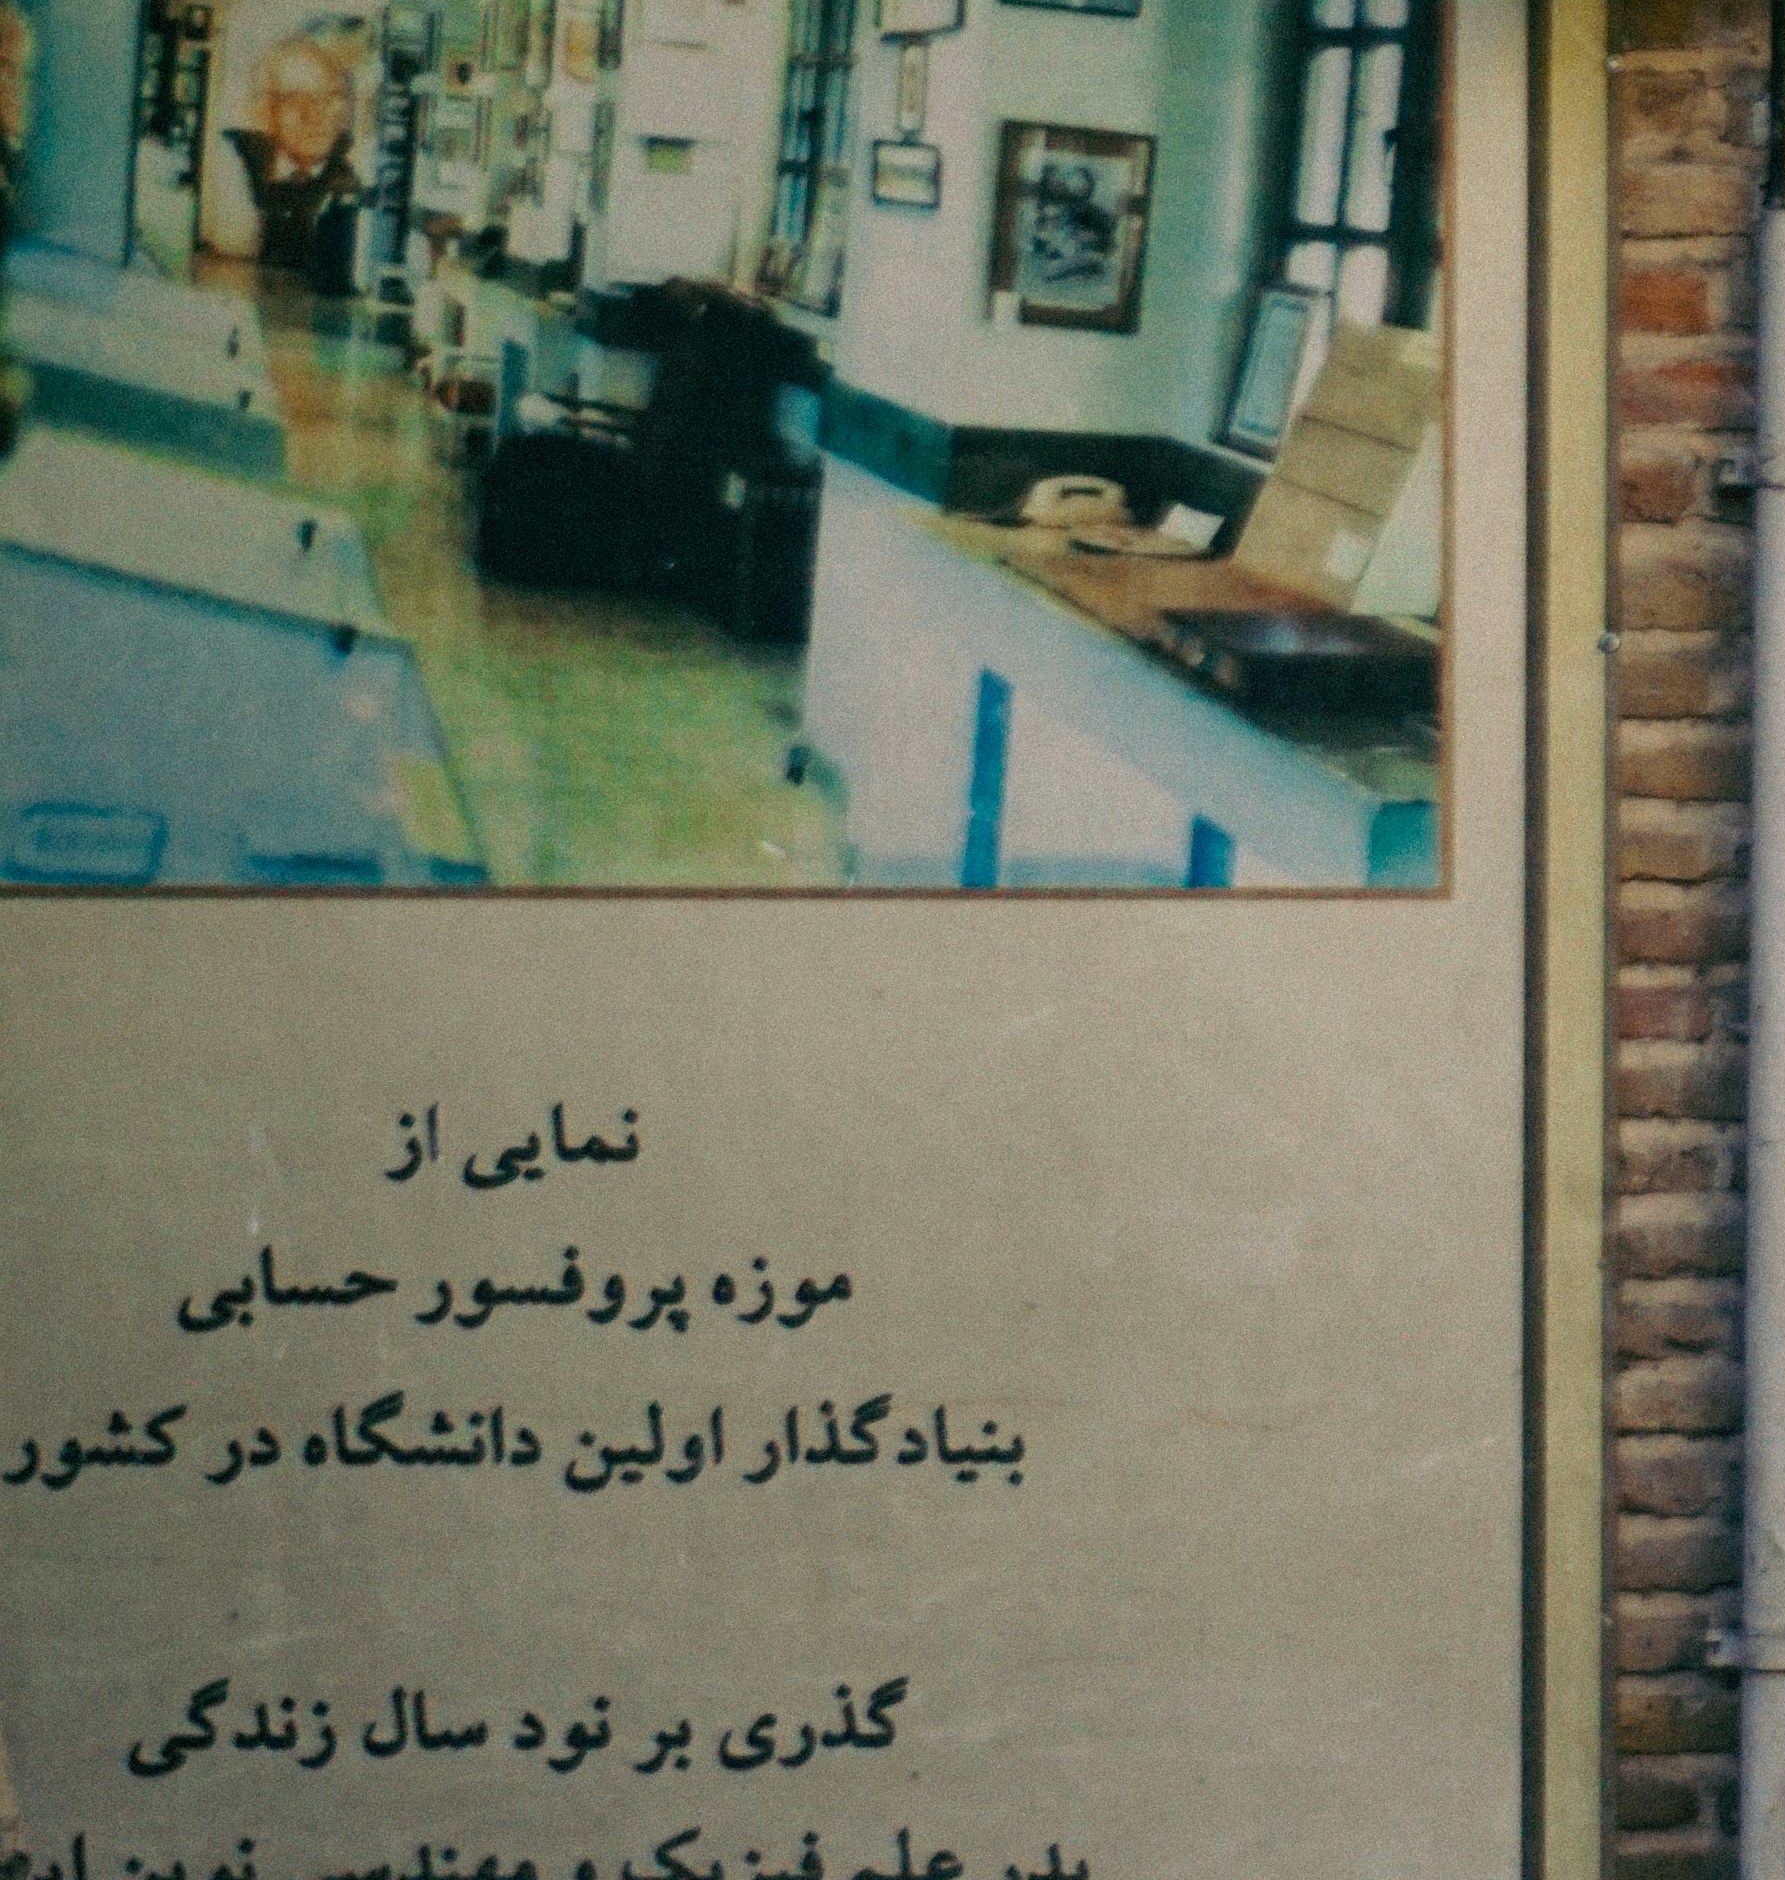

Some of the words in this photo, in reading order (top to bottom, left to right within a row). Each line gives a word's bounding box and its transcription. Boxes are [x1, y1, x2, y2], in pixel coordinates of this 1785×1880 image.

[383, 1103, 440, 1184] از
[461, 1101, 642, 1192] نمایی
[175, 1244, 399, 1335] حسابی
[414, 1242, 692, 1335] پروفسور
[709, 1252, 855, 1331] موزه
[0, 1402, 188, 1491] کشور
[205, 1426, 282, 1487] در
[301, 1390, 543, 1468] دانشگاه
[562, 1400, 726, 1495] اولین
[125, 1676, 338, 1780] زندگی
[361, 1683, 489, 1759] سال
[513, 1693, 613, 1776] نود
[633, 1718, 693, 1776] بر
[716, 1674, 912, 1775] گذری
